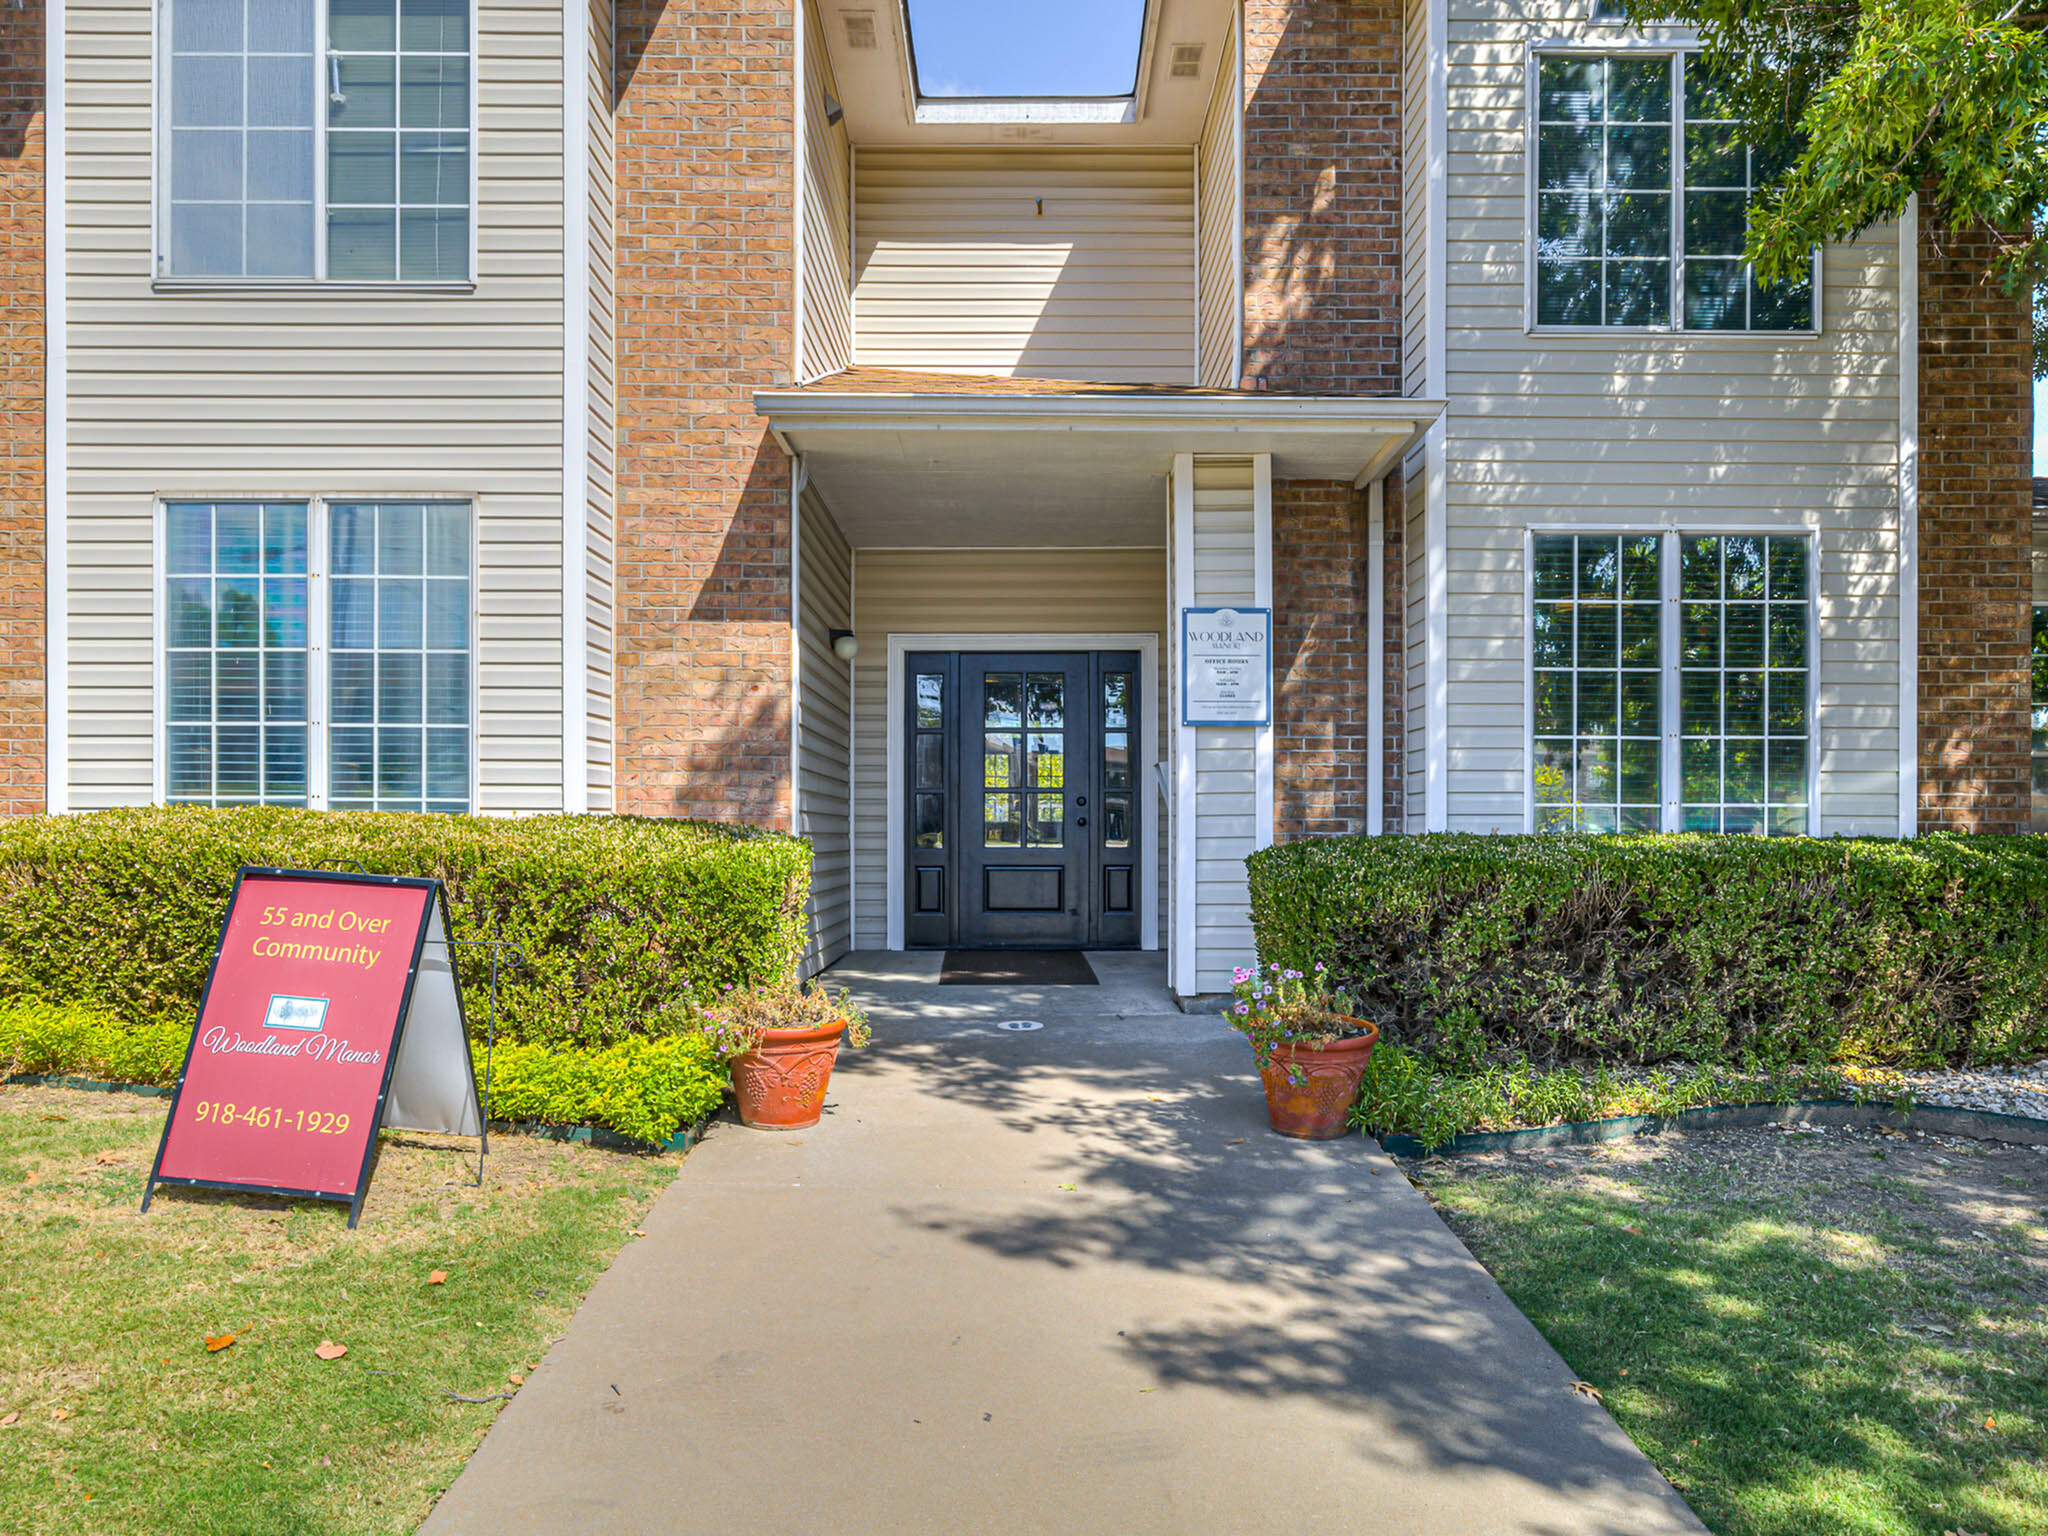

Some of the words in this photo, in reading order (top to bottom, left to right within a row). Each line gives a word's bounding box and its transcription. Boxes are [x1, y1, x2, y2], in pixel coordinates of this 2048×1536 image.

[1188, 631, 1264, 642] WOODLAND
[260, 906, 287, 927] 55
[291, 909, 335, 929] and
[338, 911, 392, 933] Over
[252, 936, 381, 969] Community
[202, 1026, 305, 1057] Woodland
[306, 1033, 381, 1065] Manor
[195, 1101, 350, 1134] 918-461-1929
